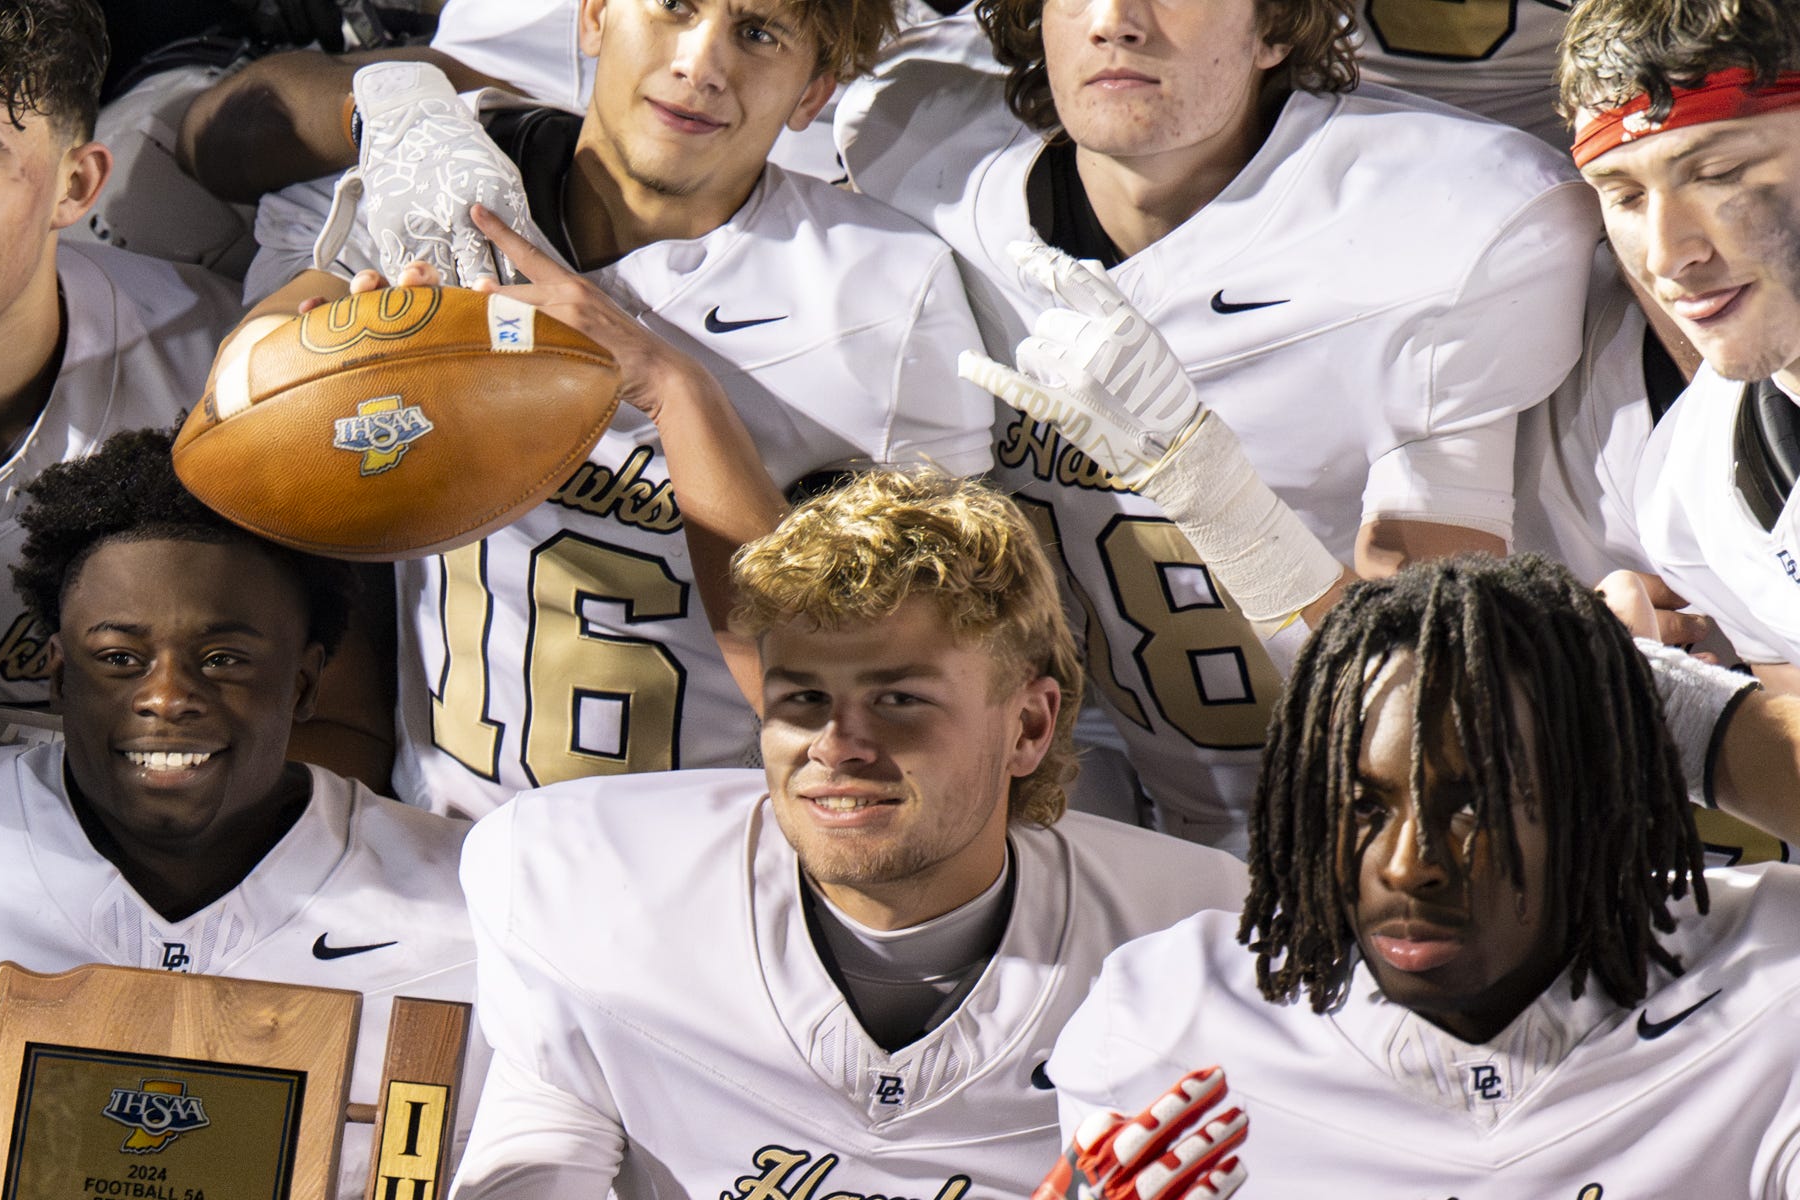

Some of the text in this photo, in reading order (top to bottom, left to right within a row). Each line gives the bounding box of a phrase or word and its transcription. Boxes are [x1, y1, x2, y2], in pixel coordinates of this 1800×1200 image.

[336, 405, 432, 451] IHSAA
[547, 445, 683, 535] wks
[430, 528, 691, 789] 16
[162, 942, 190, 974] DC
[875, 1074, 905, 1106] DC
[1470, 1065, 1502, 1100] DC
[108, 1091, 203, 1129] IHSAA
[126, 1163, 168, 1183] 2024
